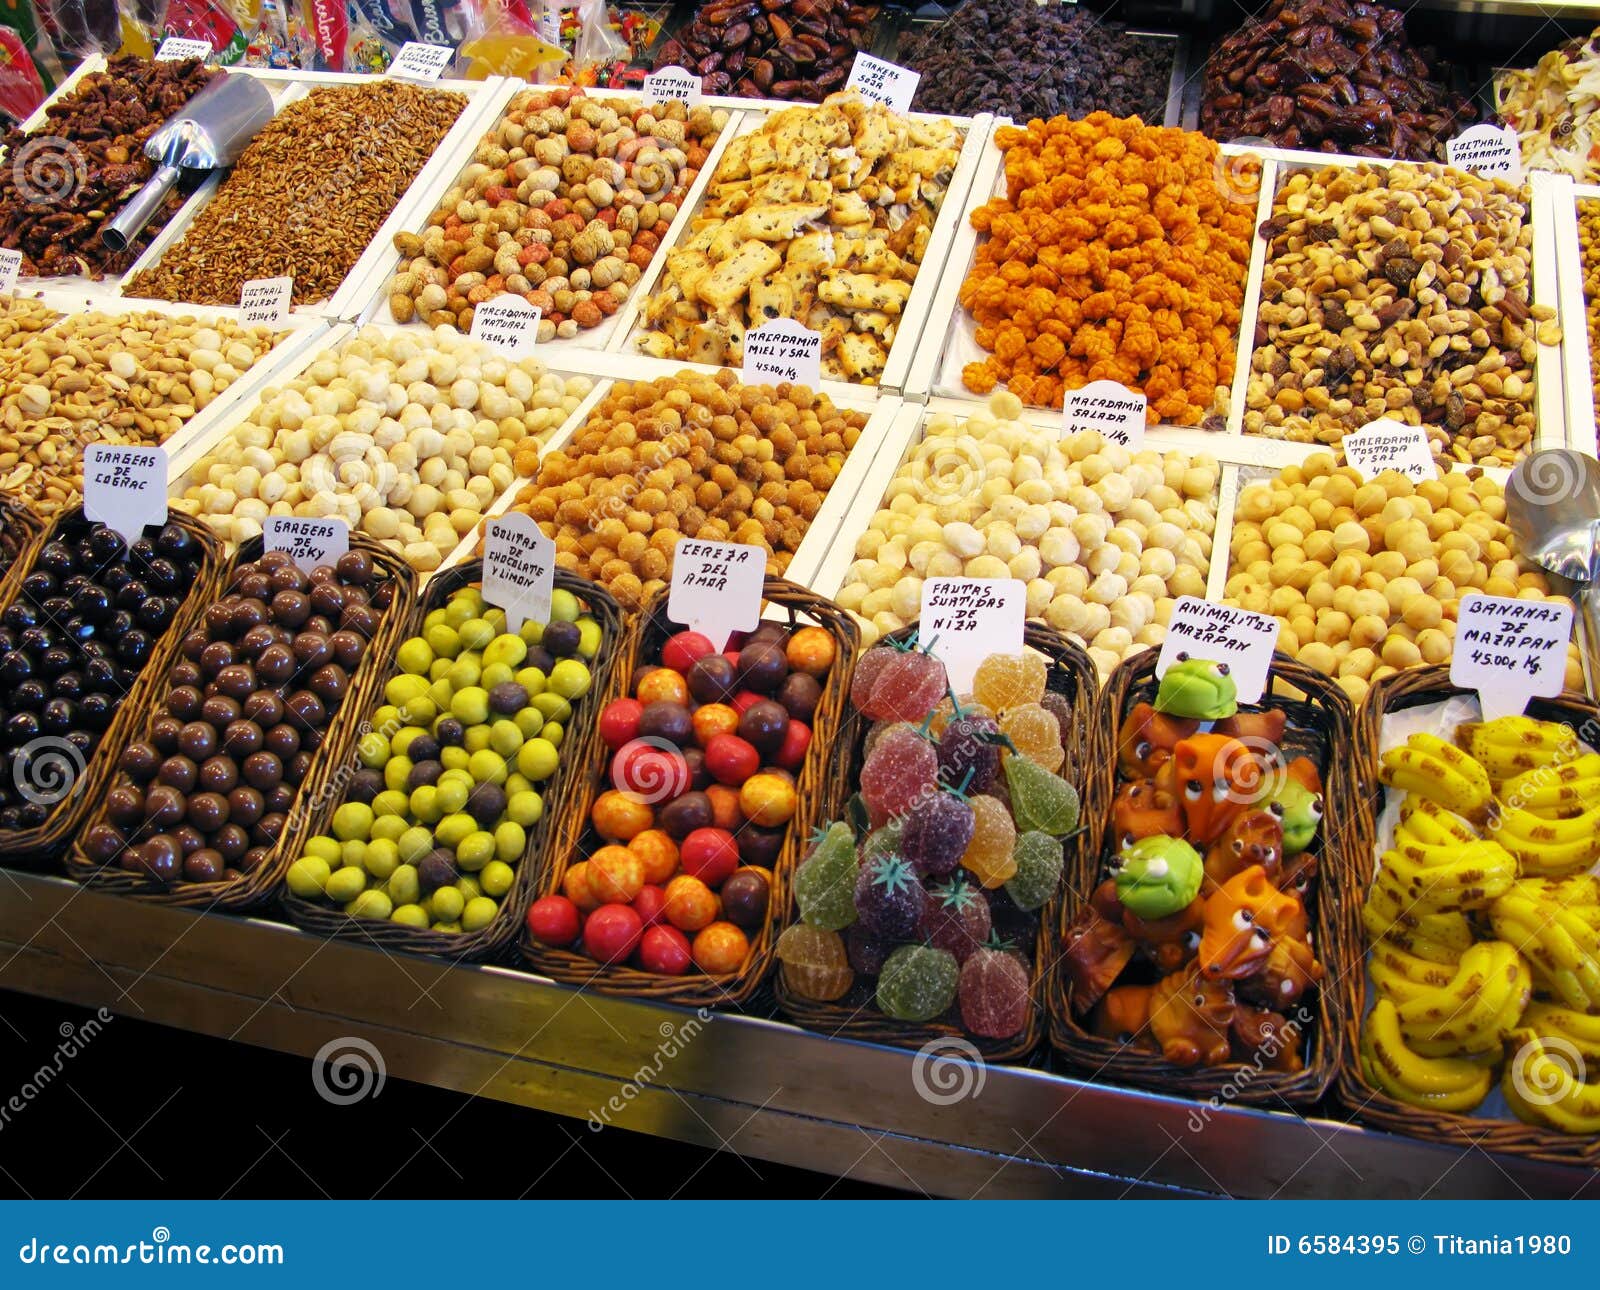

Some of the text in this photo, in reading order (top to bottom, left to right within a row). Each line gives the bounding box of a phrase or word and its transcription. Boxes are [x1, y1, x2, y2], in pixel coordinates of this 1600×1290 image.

[858, 75, 883, 89] SOJA
[872, 73, 885, 81] DE
[652, 88, 689, 98] JUMBO
[748, 345, 774, 356] MIEL
[789, 349, 810, 358] SAL
[1072, 409, 1126, 423] SALADA
[1348, 434, 1420, 447] MACADAMIA
[1351, 445, 1408, 455] TOSTADA
[1371, 454, 1395, 463] SAL
[114, 466, 131, 476] DE
[294, 538, 312, 547] DE
[492, 525, 537, 550] BOLITAS
[509, 546, 523, 558] DE
[682, 543, 749, 563] CEREZA
[489, 551, 544, 577] CHOCOLATE
[701, 563, 728, 575] DEL
[683, 573, 727, 591] AMOR
[954, 609, 977, 619] DE
[1178, 602, 1274, 632] ANIMALITOS
[1469, 601, 1561, 622] BANANAS
[933, 618, 977, 631] NIZA
[1205, 622, 1230, 633] DE
[1501, 622, 1528, 633] DE
[1171, 622, 1251, 651] MAZAPAN
[1464, 629, 1558, 650] MAZAPAN
